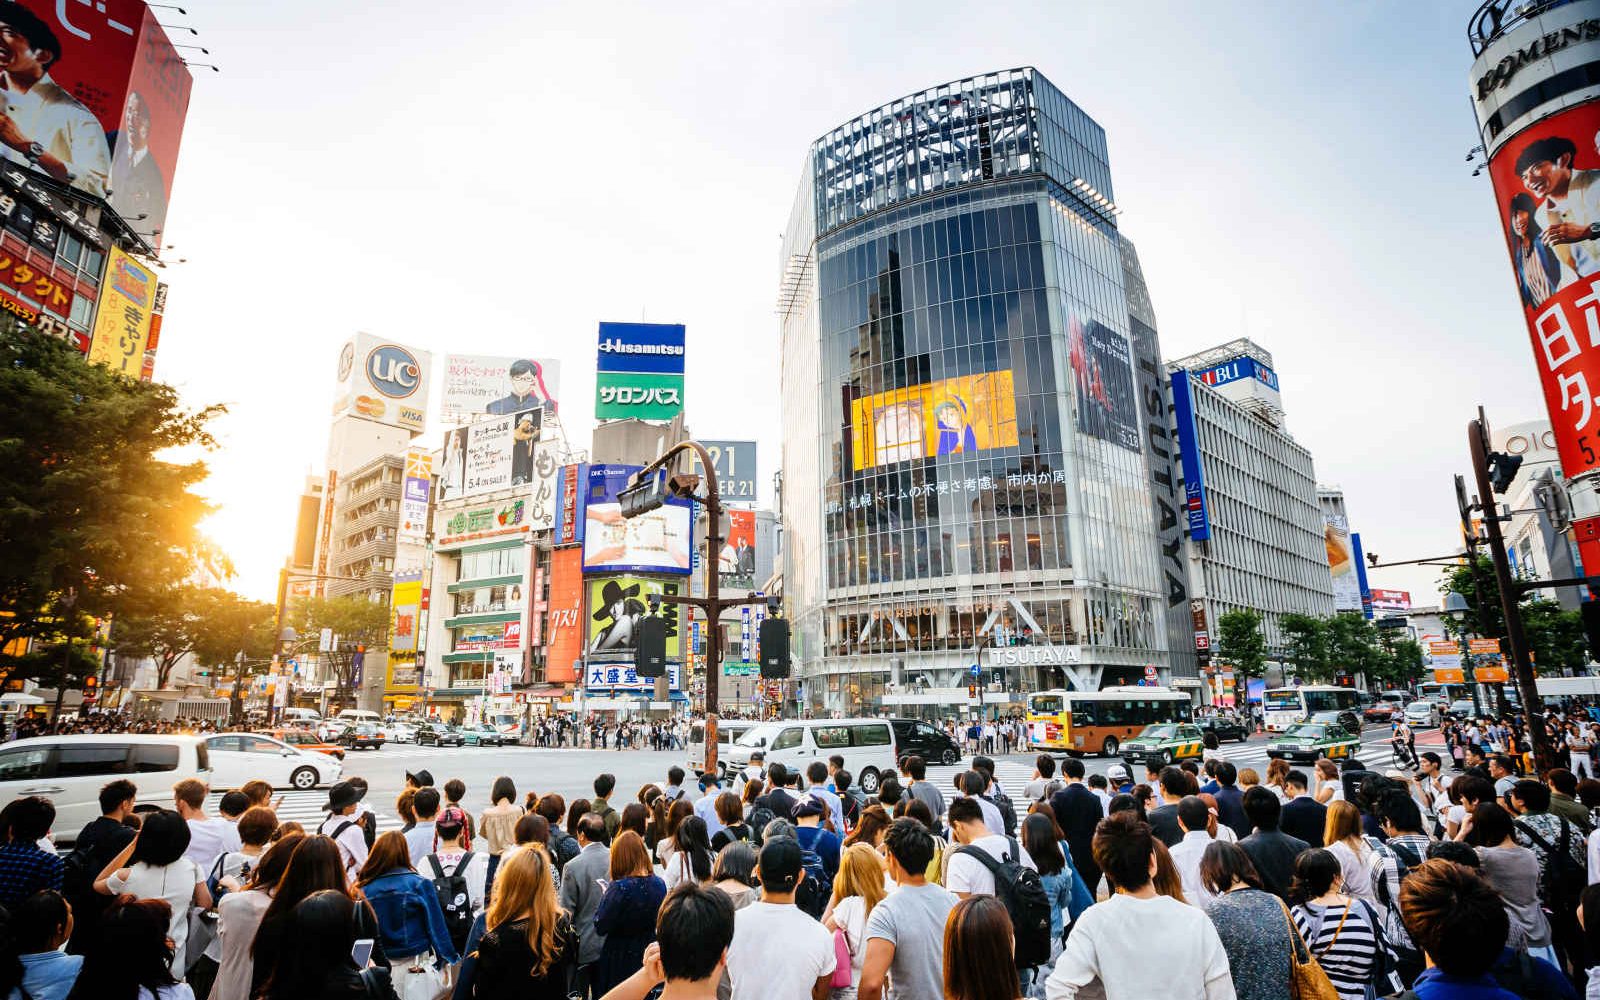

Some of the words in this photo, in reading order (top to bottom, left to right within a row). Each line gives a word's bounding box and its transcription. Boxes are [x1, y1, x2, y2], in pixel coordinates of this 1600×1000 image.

[0, 297, 37, 321] レストラン
[598, 338, 684, 355] Hisamitsu
[600, 386, 681, 405] サロンパス
[401, 410, 423, 422] VISA
[1141, 358, 1186, 608] TSUTAYA
[992, 647, 1080, 665] TSUTAYA
